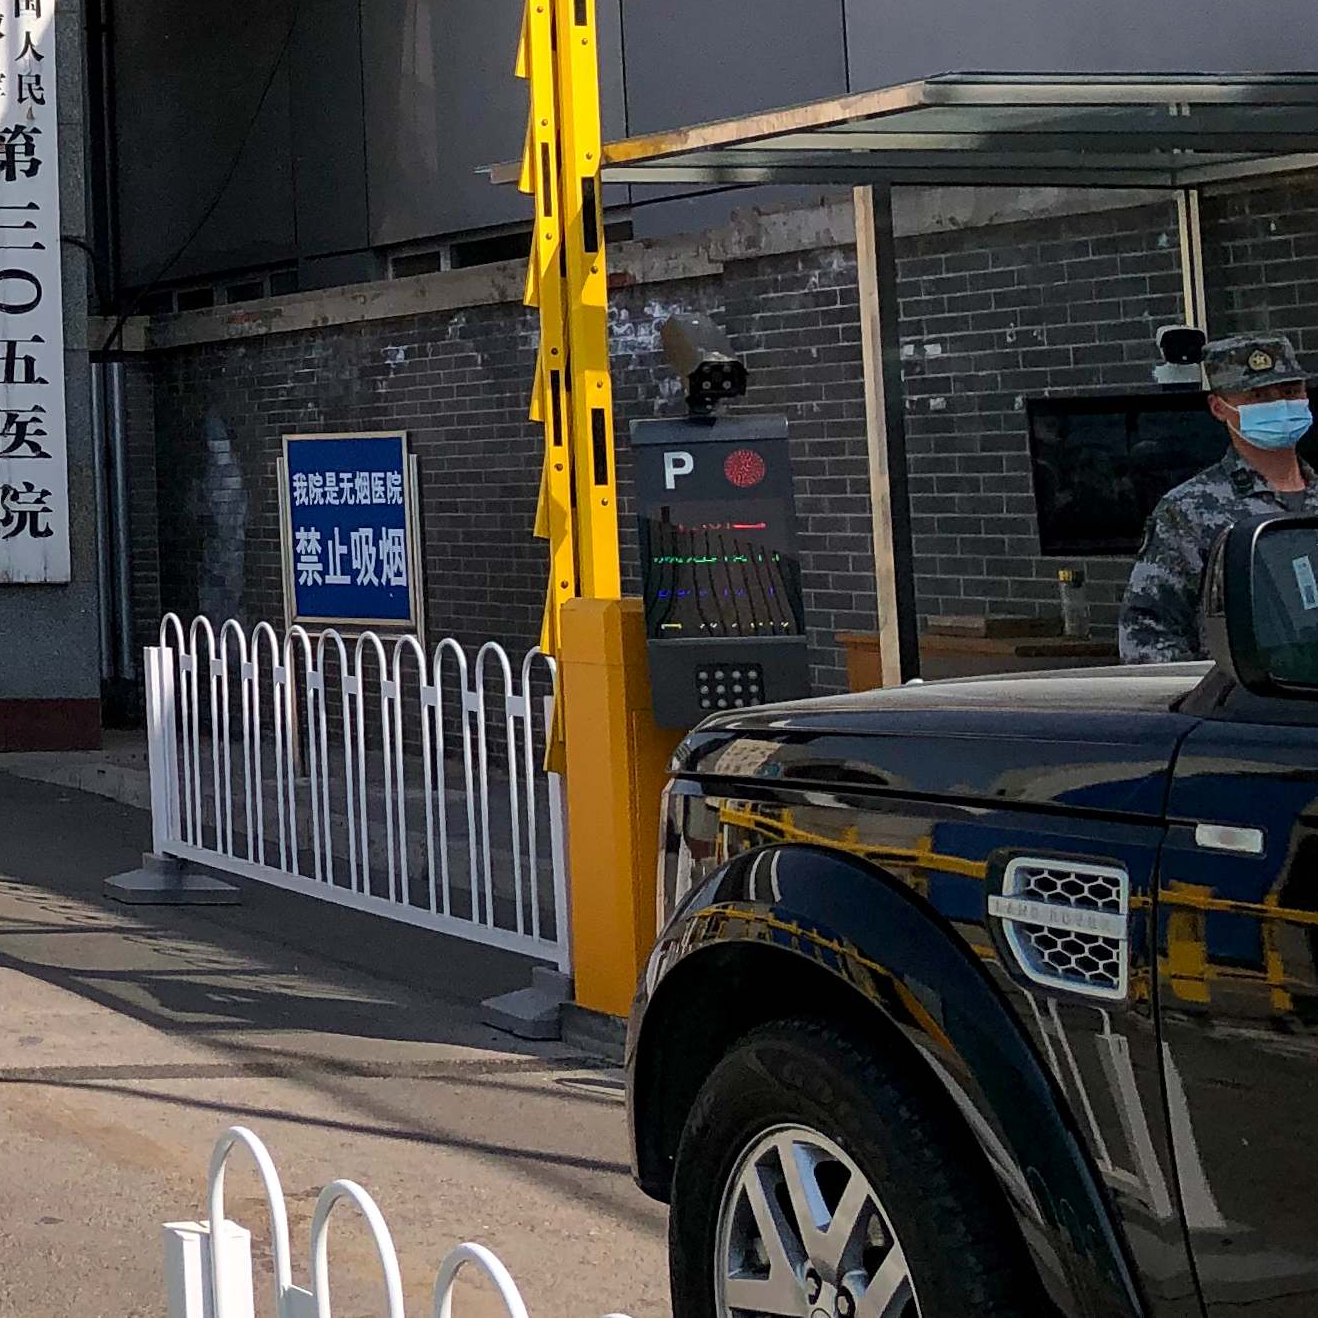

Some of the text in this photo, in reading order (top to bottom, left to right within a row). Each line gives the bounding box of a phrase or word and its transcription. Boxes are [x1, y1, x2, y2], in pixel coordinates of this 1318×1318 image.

[292, 470, 404, 507] 我院是无烟医院
[664, 450, 695, 490] P
[295, 526, 408, 587] 禁止吸烟
